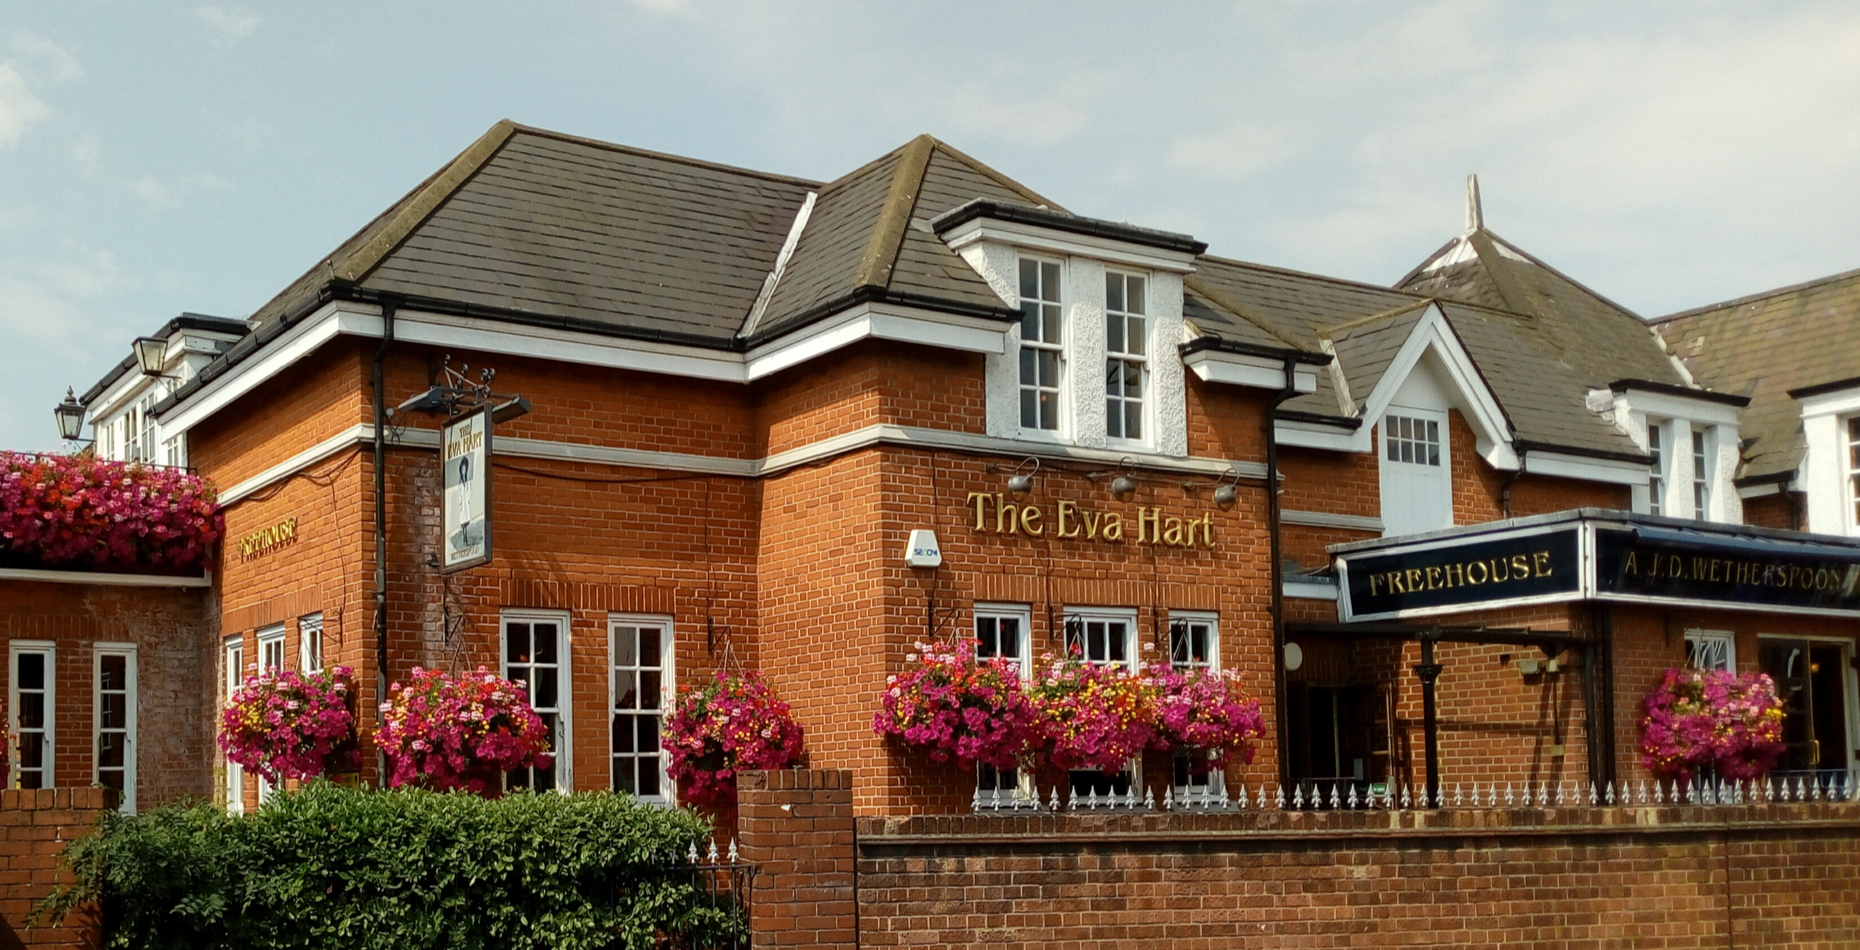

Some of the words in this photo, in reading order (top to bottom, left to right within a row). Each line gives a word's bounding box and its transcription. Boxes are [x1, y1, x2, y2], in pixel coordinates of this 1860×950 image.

[447, 440, 461, 460] EVA
[463, 431, 483, 453] HART
[459, 424, 471, 438] THE
[967, 492, 1043, 537] The
[1056, 499, 1123, 542] Eva
[1138, 506, 1216, 548] Hart
[1369, 550, 1553, 597] FREEHOUSE
[1625, 551, 1638, 575] A
